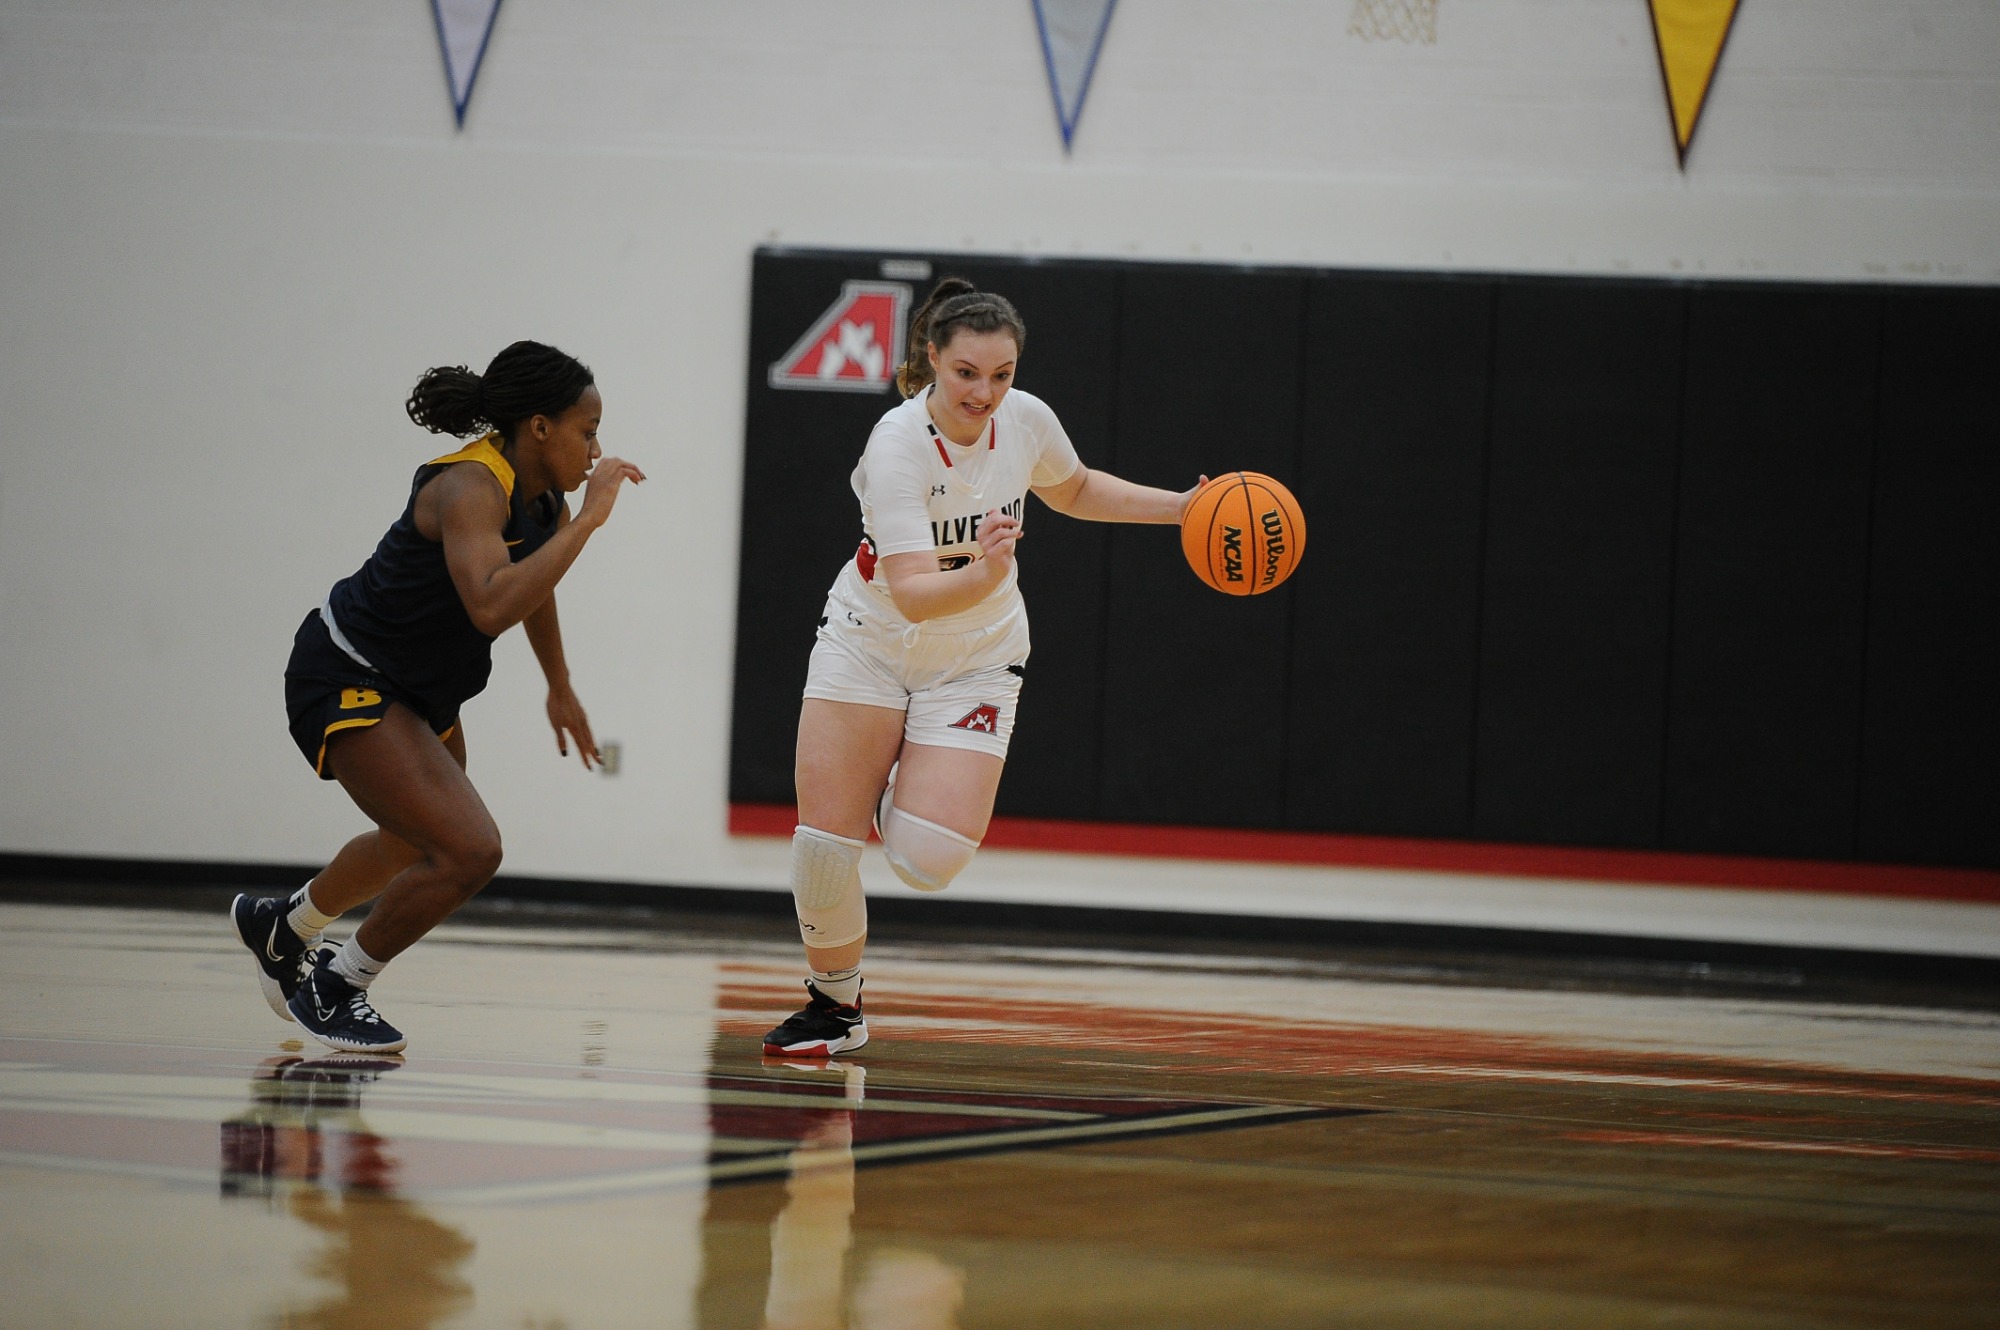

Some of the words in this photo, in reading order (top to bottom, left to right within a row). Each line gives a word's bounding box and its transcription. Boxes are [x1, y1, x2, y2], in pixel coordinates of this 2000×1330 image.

[1224, 525, 1244, 583] NCAA
[1261, 508, 1285, 587] Wilson
[340, 687, 382, 709] B
